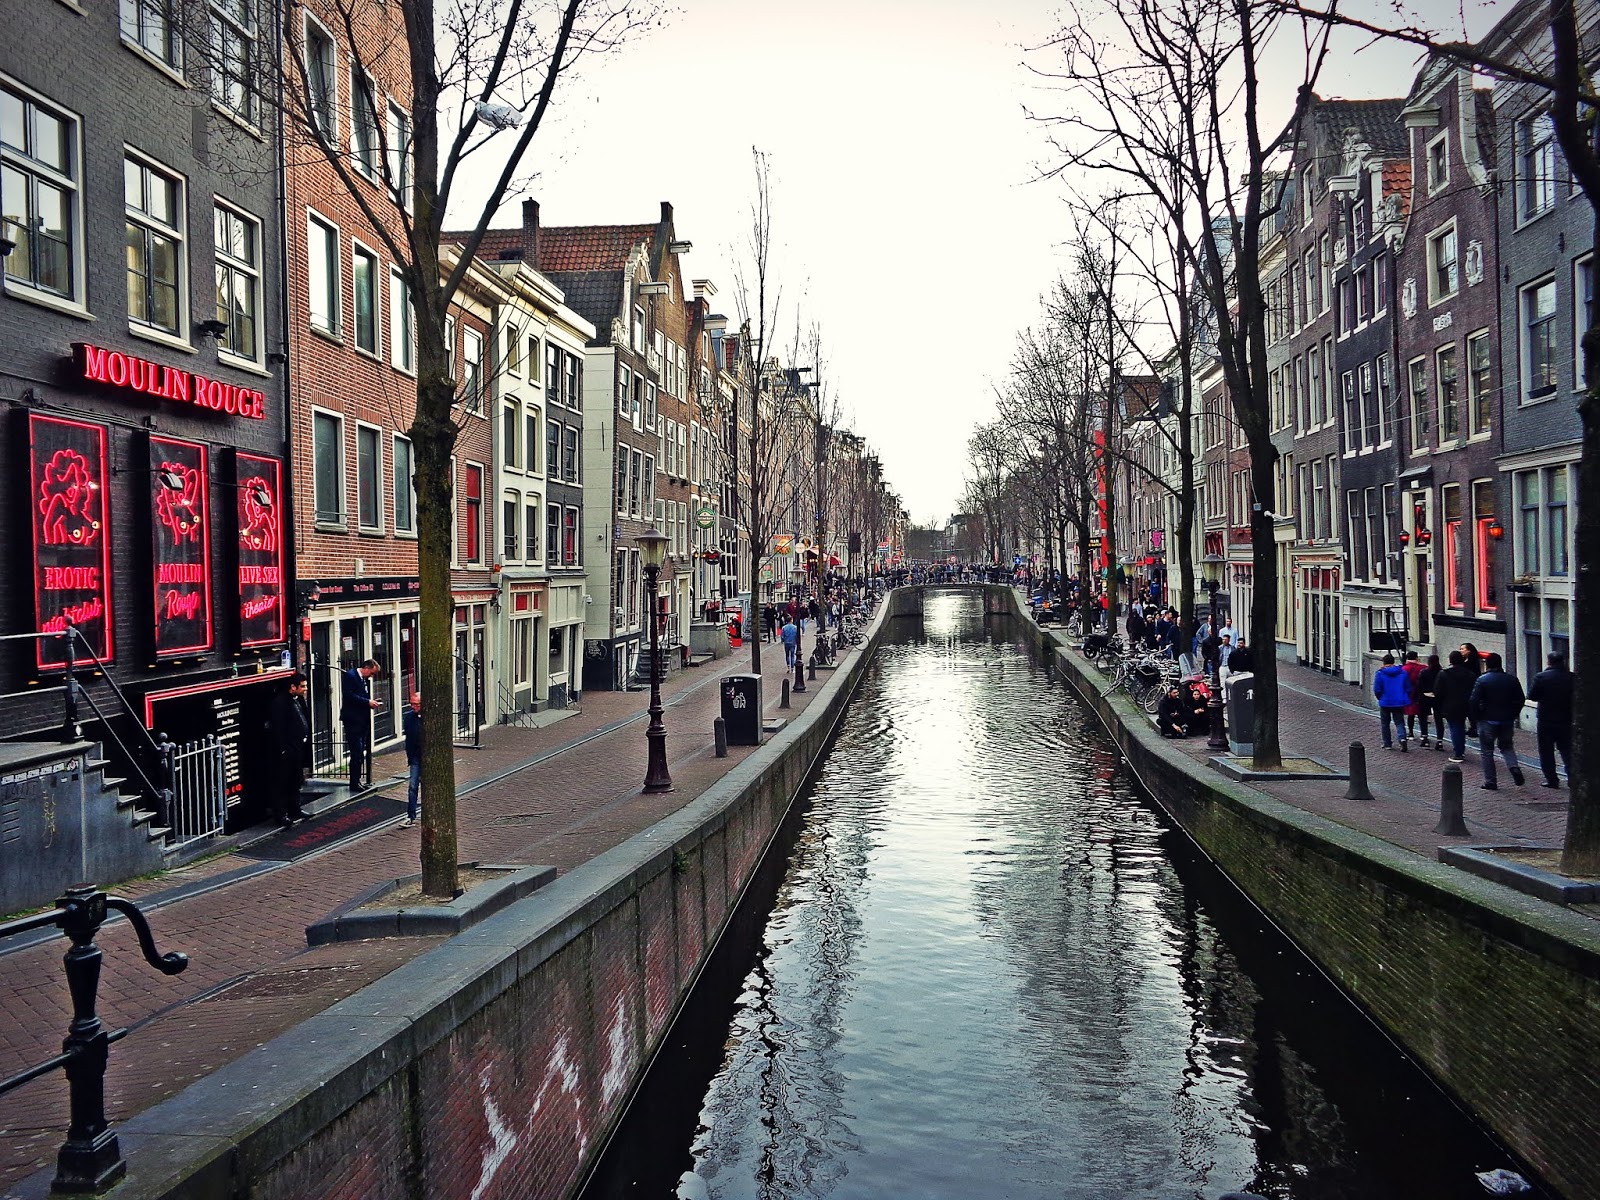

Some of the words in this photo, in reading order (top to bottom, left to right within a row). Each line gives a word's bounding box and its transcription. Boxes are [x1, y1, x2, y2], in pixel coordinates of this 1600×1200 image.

[83, 344, 191, 401] MOULIN
[194, 374, 265, 420] ROUGE
[44, 567, 99, 590] EROTIC
[158, 563, 203, 584] MOULIN
[240, 566, 262, 584] LIVE
[263, 566, 279, 584] SEX
[164, 589, 201, 620] Rouge
[242, 594, 278, 619] theater
